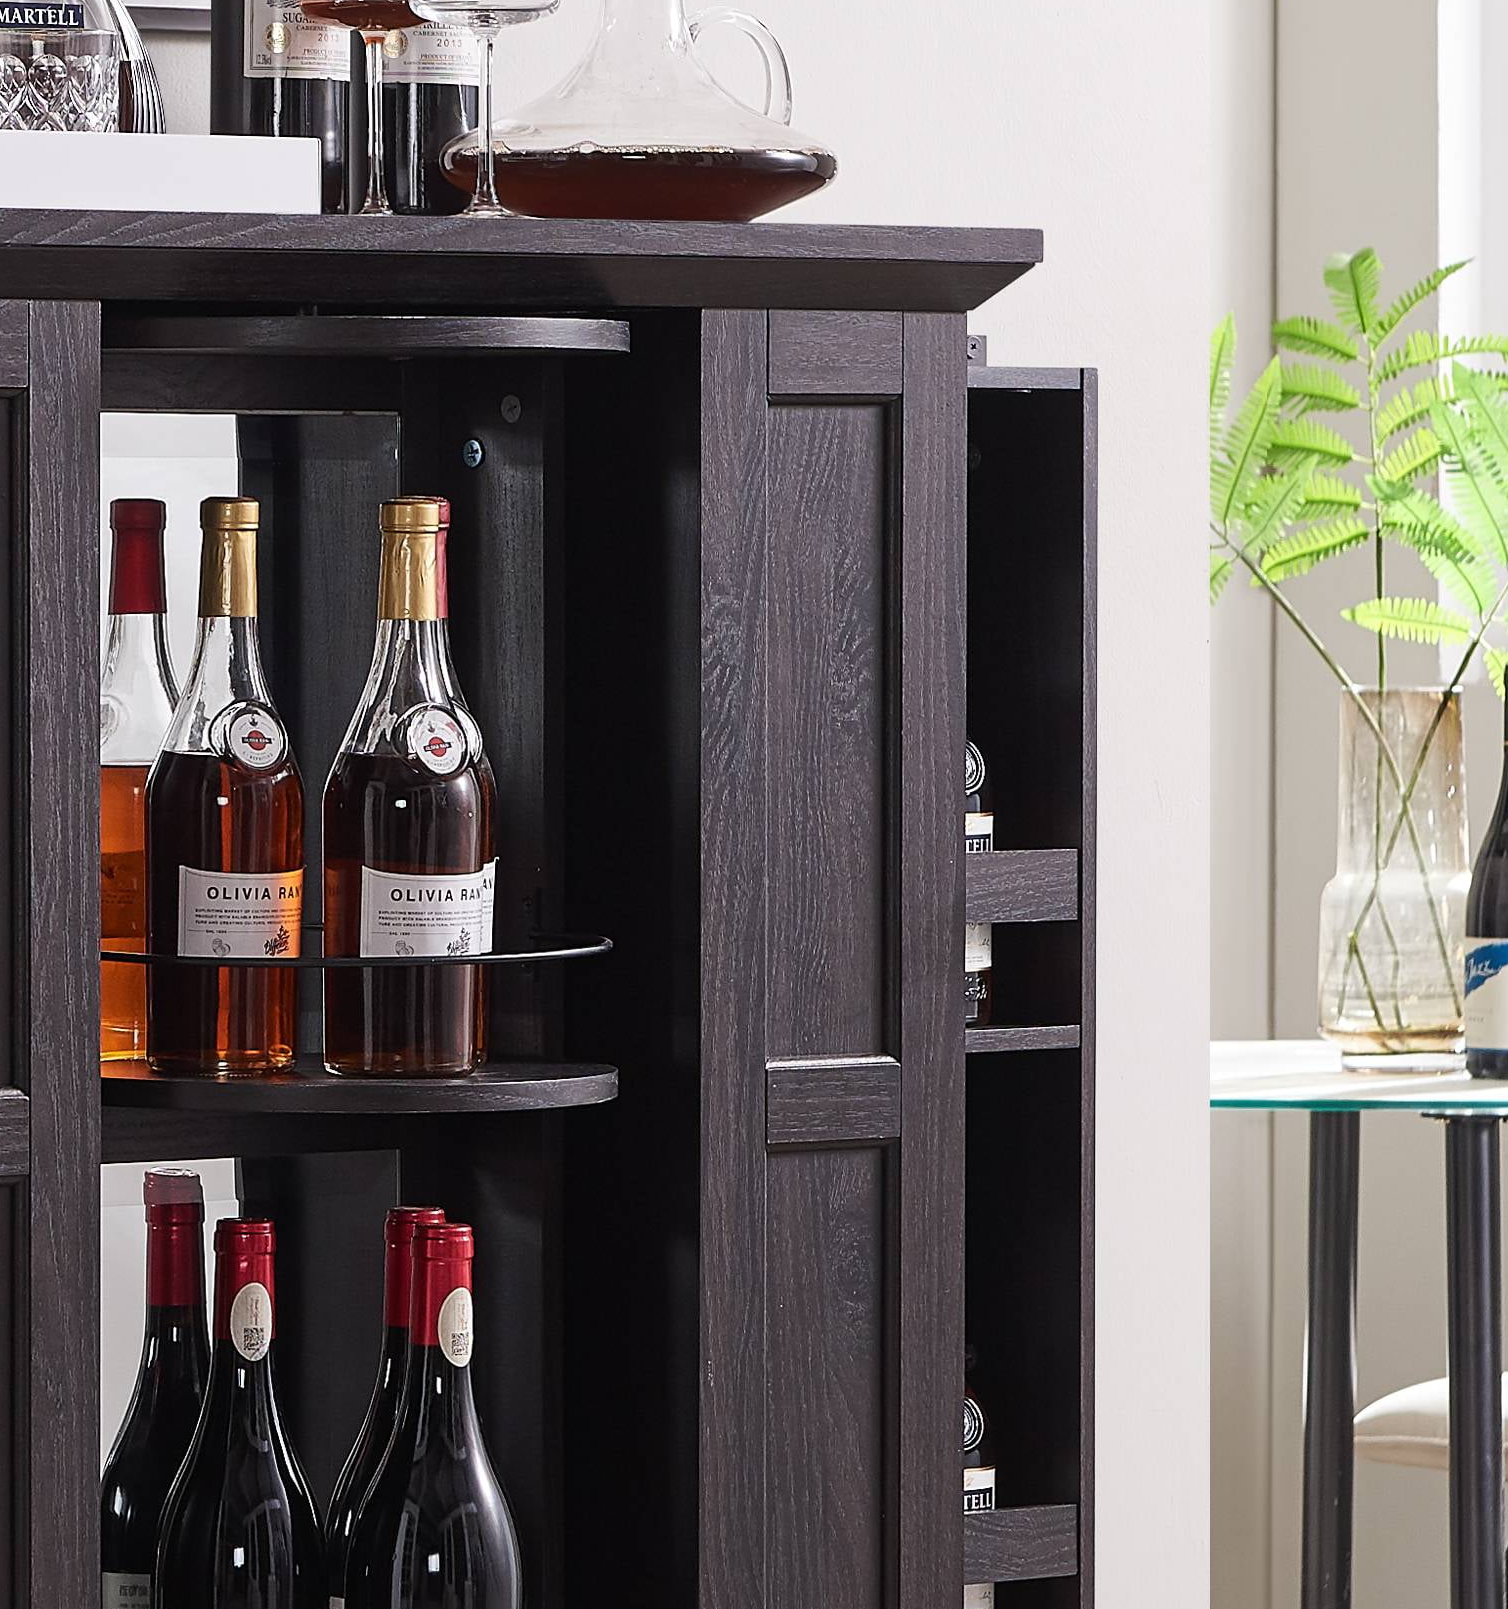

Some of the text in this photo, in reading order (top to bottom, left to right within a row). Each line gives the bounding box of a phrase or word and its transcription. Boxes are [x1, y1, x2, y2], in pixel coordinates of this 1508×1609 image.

[966, 839, 990, 852] TELL
[207, 887, 271, 901] OLIVIA
[390, 888, 454, 902] OLIVIA
[964, 1493, 991, 1510] TELL
